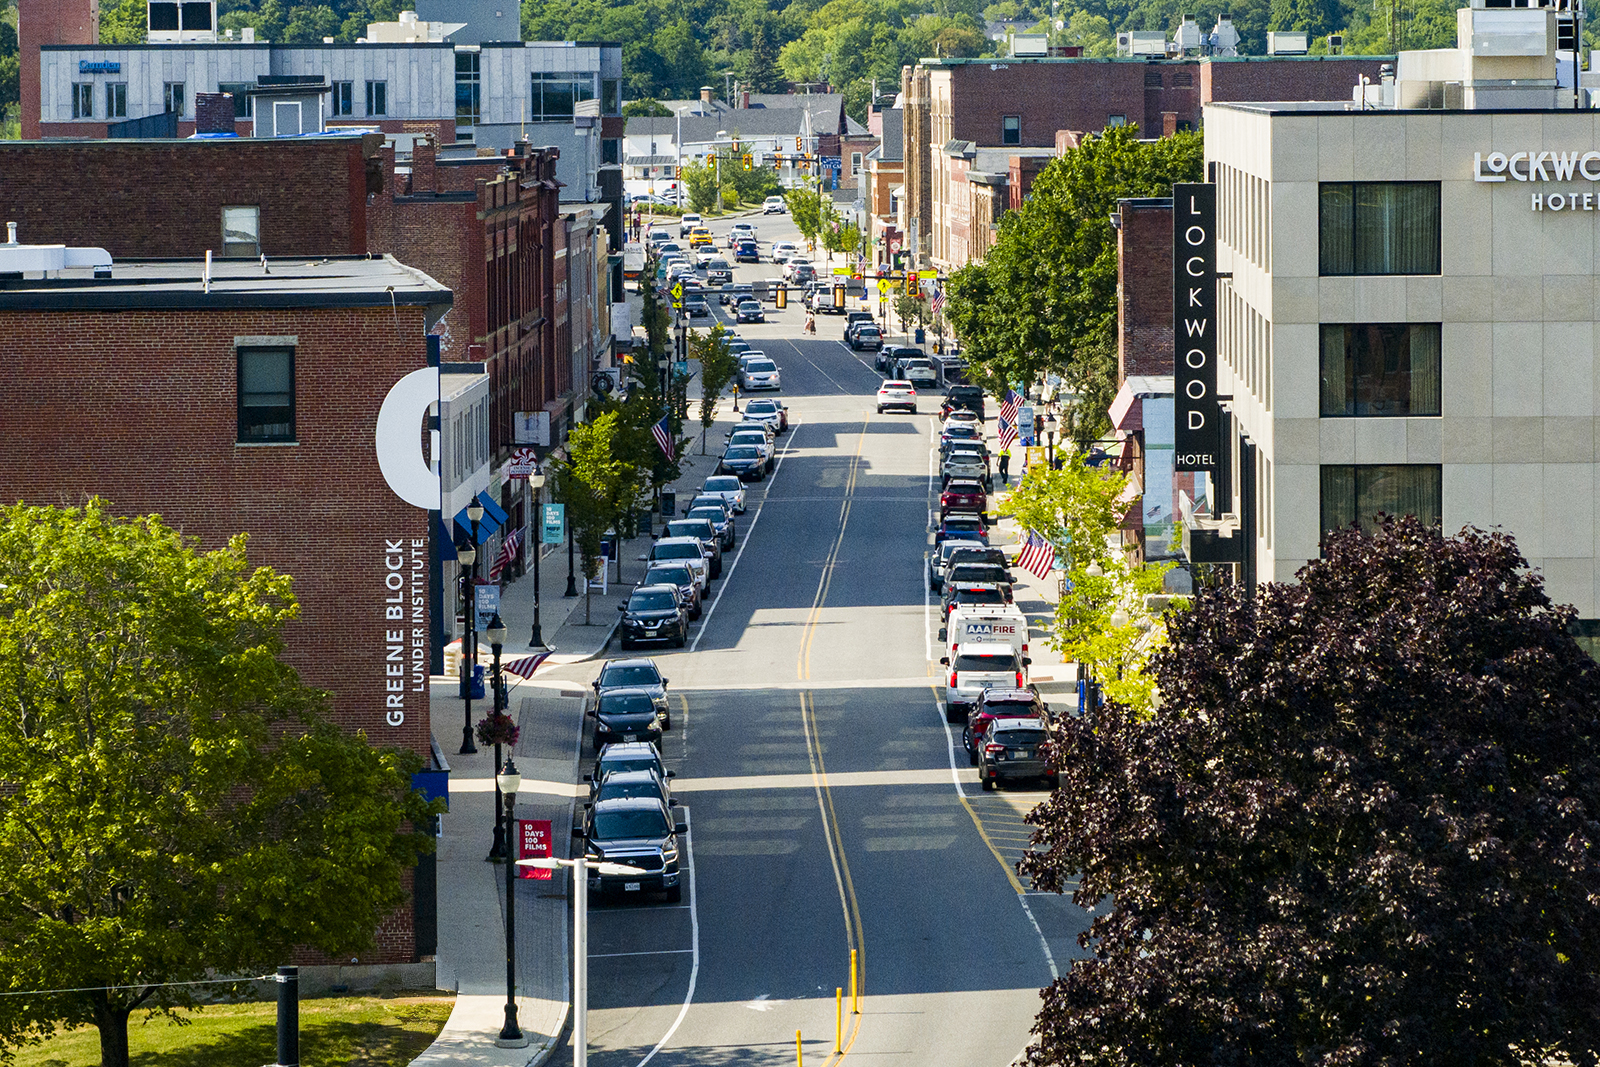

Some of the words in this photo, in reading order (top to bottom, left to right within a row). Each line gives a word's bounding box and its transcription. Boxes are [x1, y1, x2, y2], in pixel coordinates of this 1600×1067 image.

[79, 60, 120, 69] Camden
[1474, 151, 1600, 182] LOCKWO
[1531, 193, 1600, 211] HOTE
[1185, 196, 1206, 430] LOCKWOOD
[1177, 455, 1215, 465] HOTEL
[386, 539, 403, 620] BLOCK
[412, 538, 424, 623] INSTITUTE
[968, 625, 991, 633] AAA
[386, 629, 404, 726] GREENE
[412, 628, 424, 692] LUNDER
